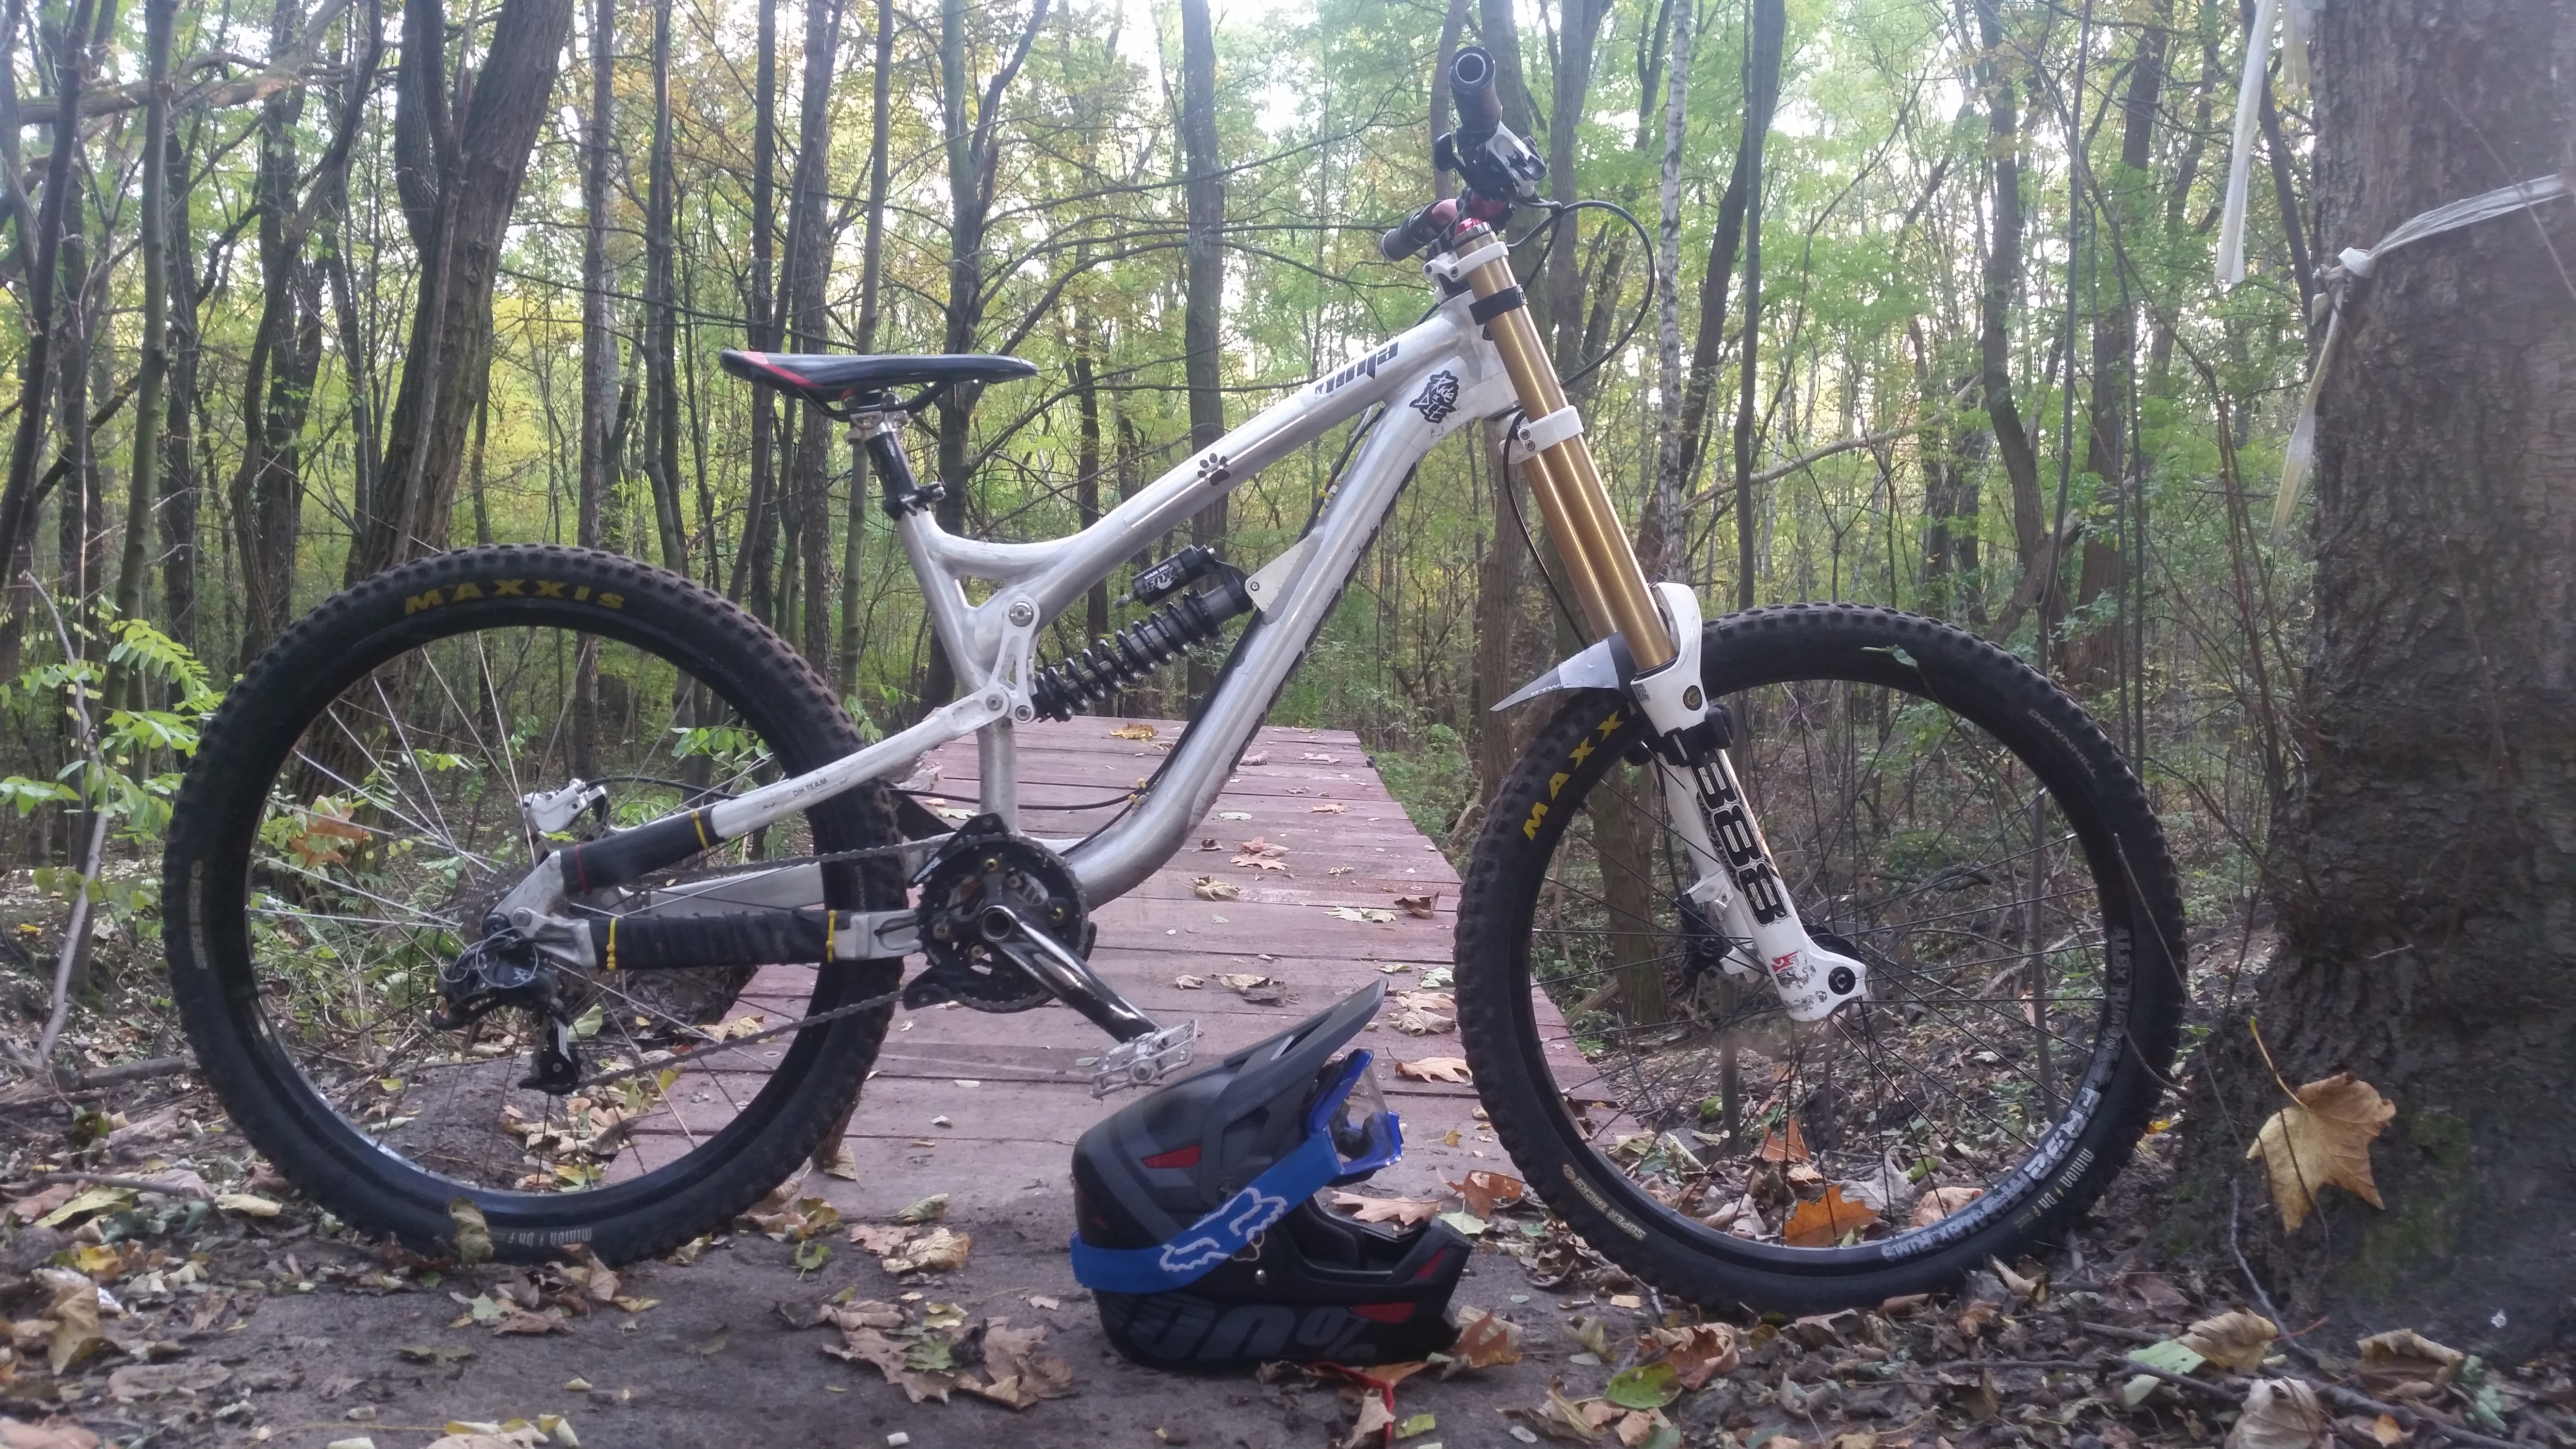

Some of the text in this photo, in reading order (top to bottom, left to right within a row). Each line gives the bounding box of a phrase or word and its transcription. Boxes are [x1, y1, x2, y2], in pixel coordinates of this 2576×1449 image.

[1414, 390, 1449, 420] DIE
[1144, 571, 1159, 580] VAN
[1146, 568, 1178, 592] FOX
[405, 579, 625, 615] MAXXIS
[2028, 708, 2096, 778] DOWNHILL
[792, 787, 805, 797] DH
[805, 777, 828, 791] TEAM
[1523, 702, 1636, 841] MAXX
[1575, 1177, 1609, 1212] TACKY
[1607, 1208, 1647, 1240] SUPER
